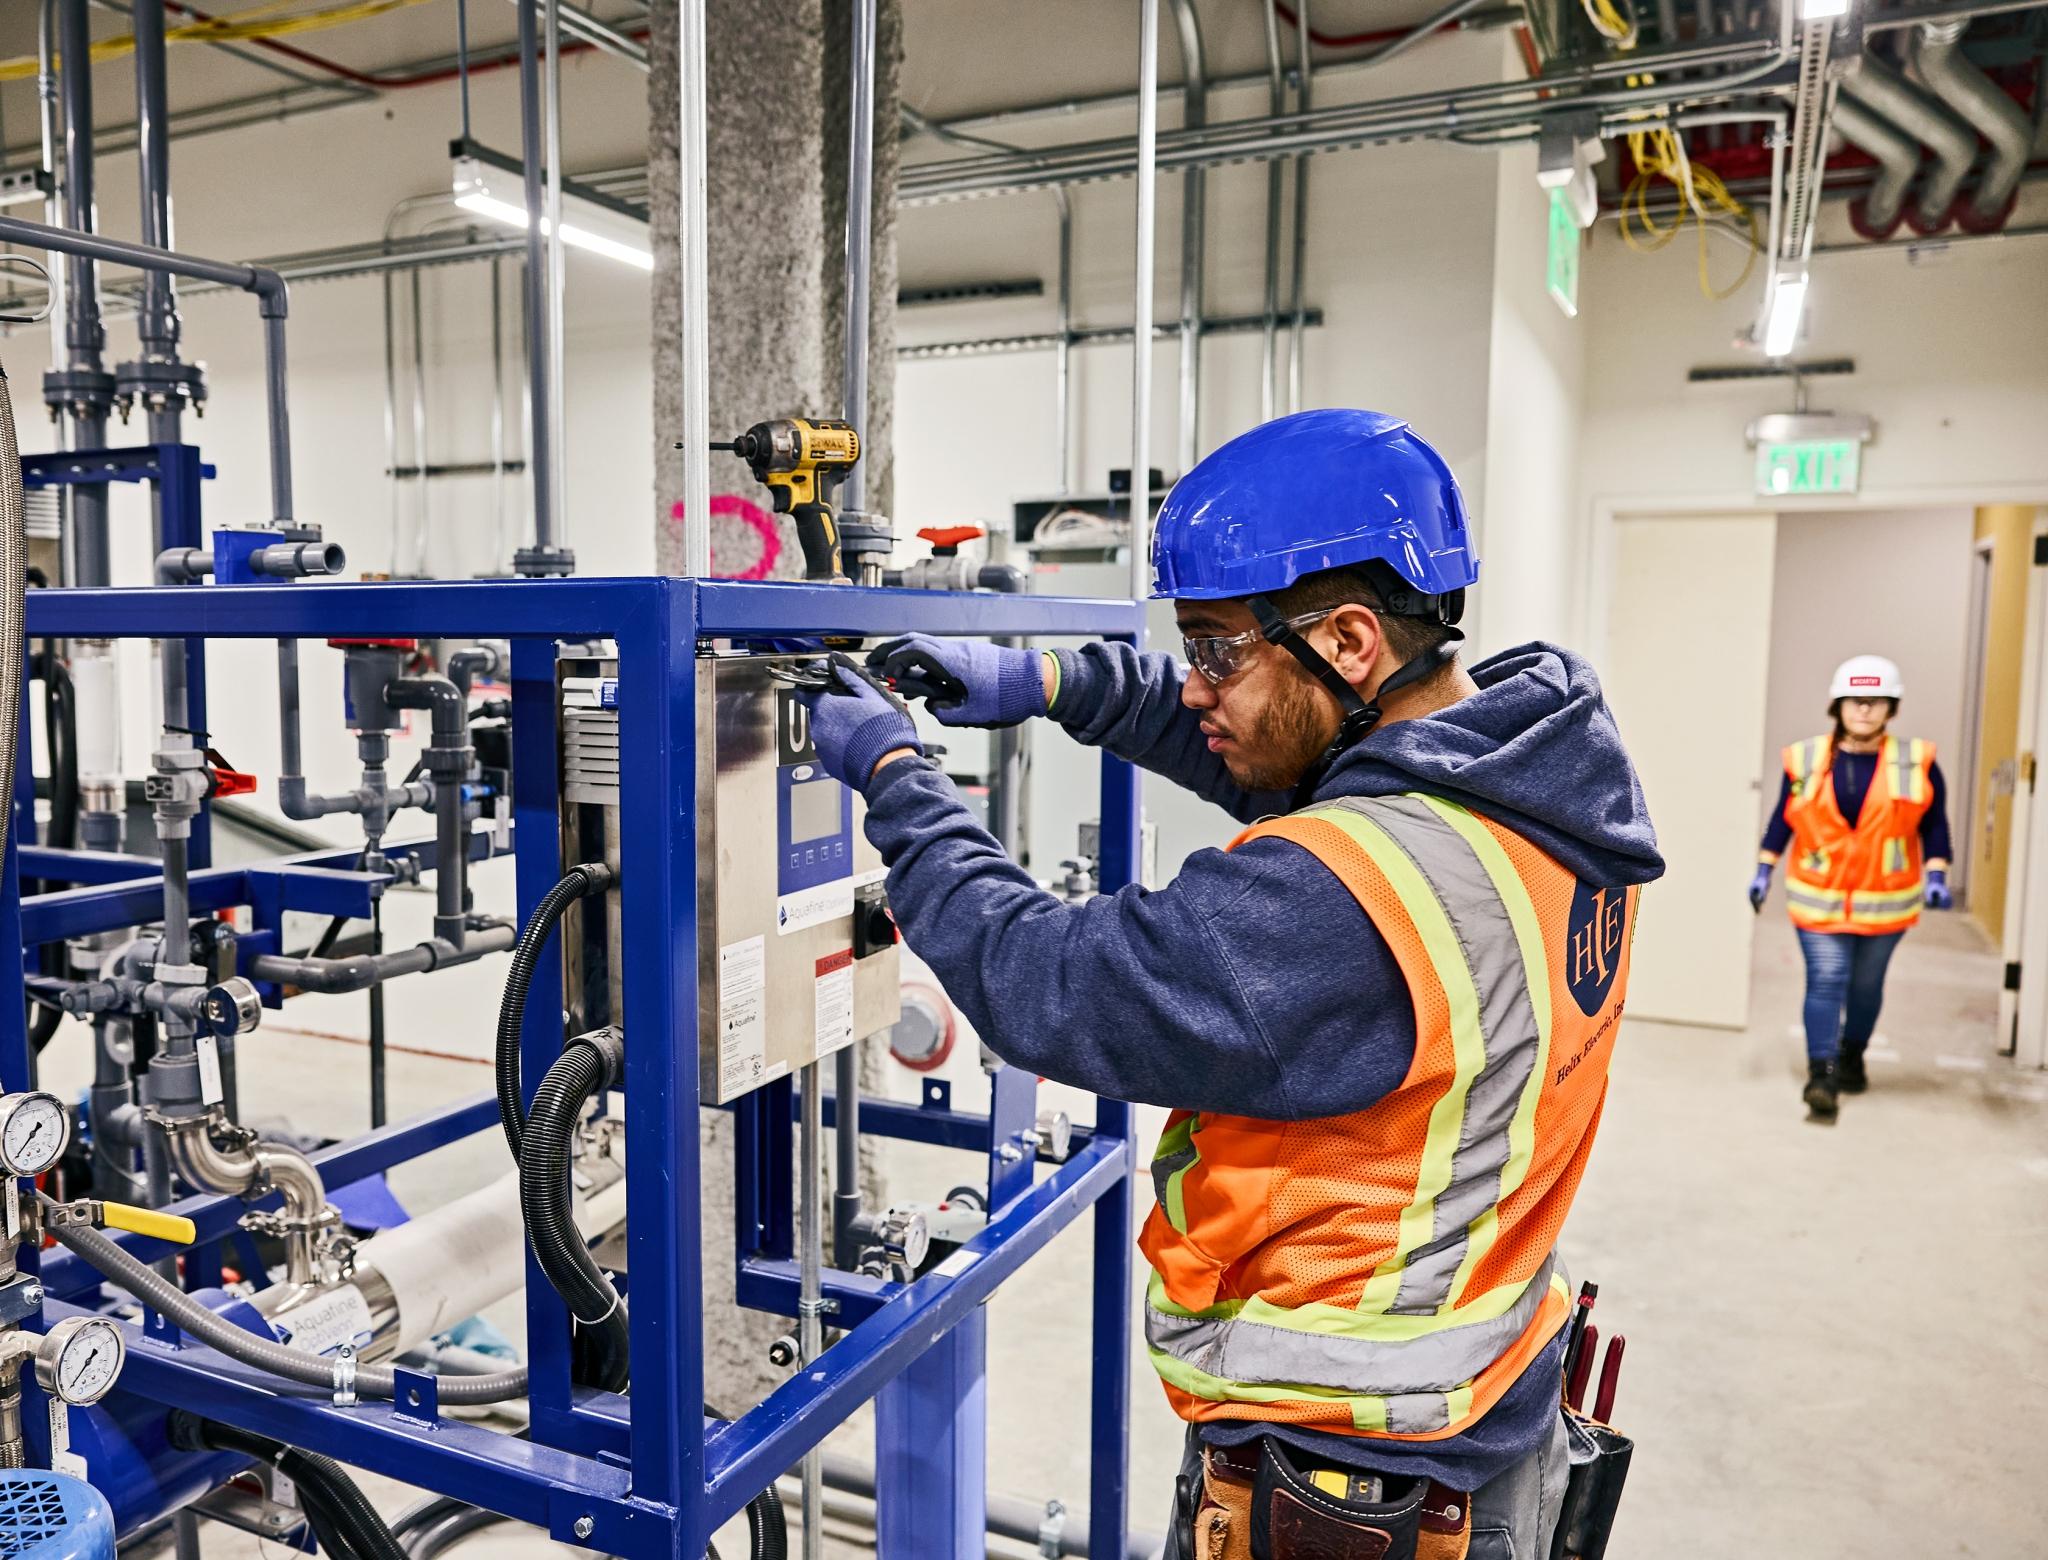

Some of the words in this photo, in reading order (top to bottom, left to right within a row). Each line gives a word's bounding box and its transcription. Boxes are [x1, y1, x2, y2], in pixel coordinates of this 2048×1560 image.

[1768, 444, 1850, 492] EXIT
[1556, 1052, 1582, 1086] Helix
[294, 1295, 358, 1335] Aquafine
